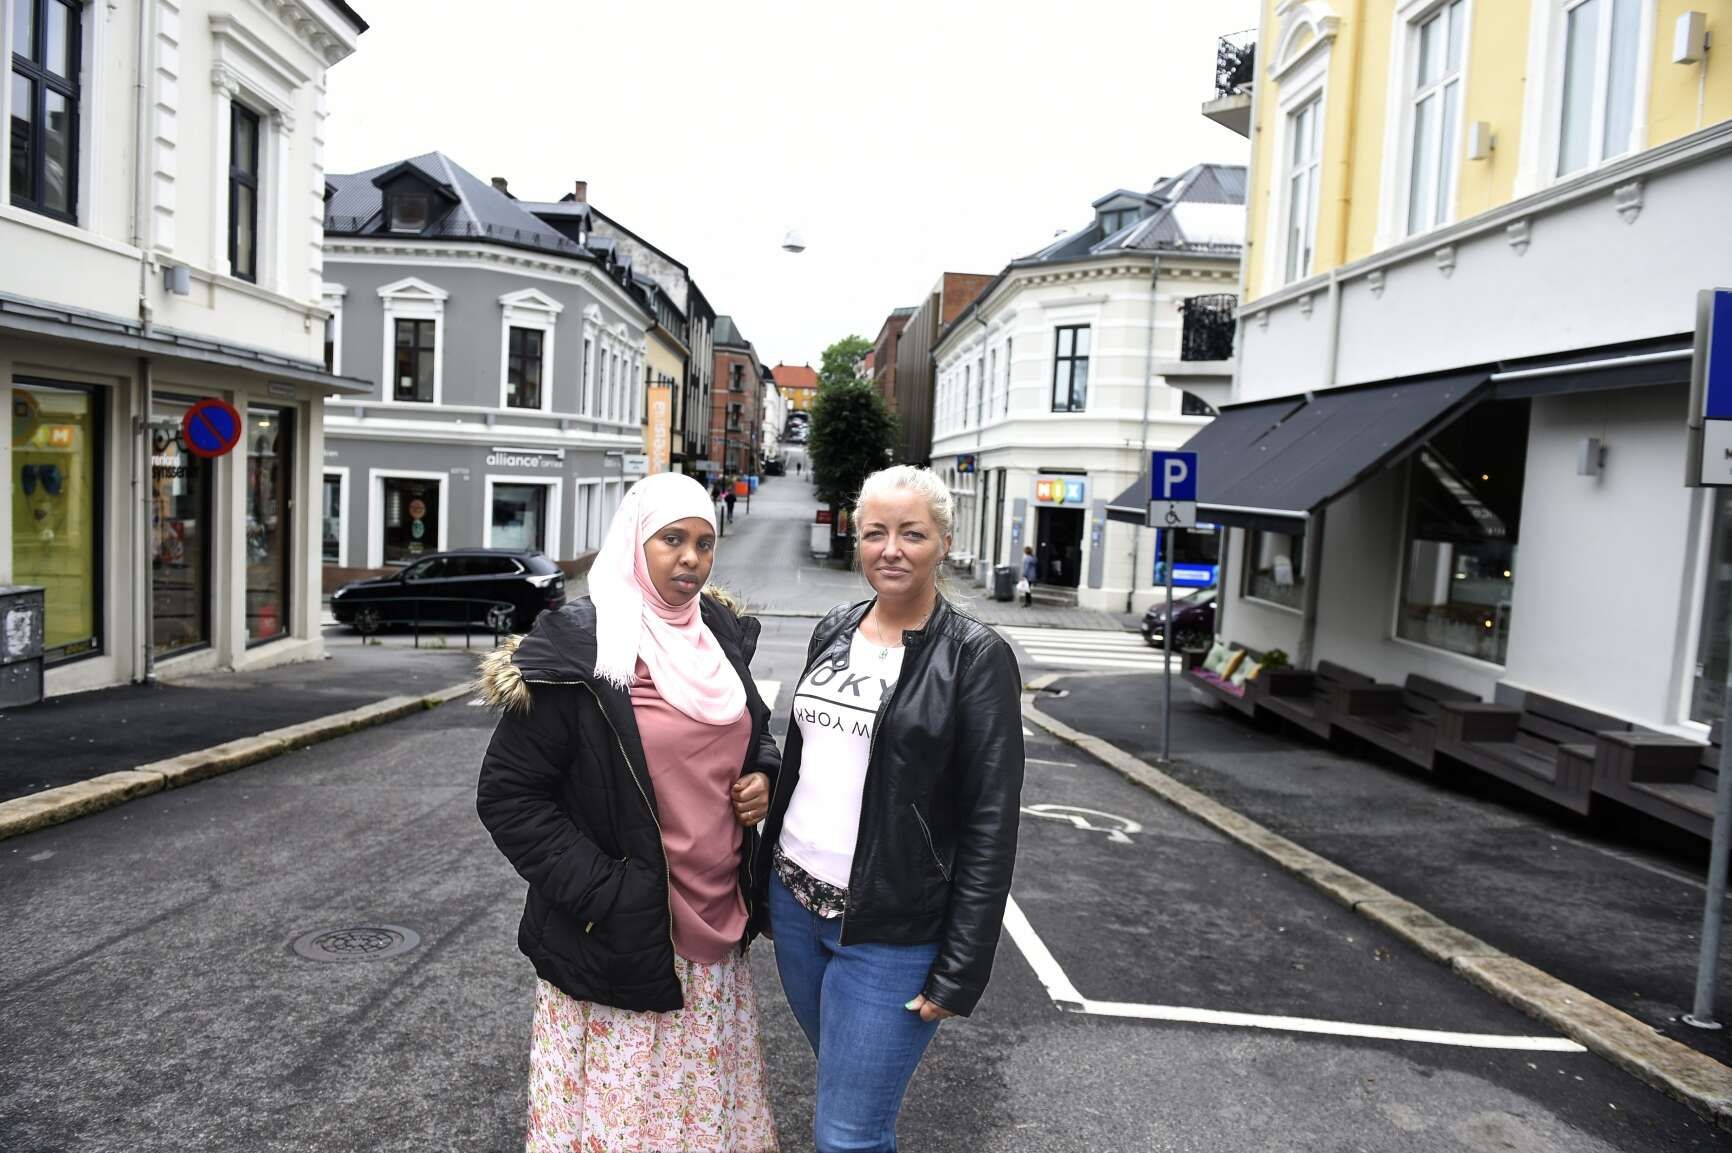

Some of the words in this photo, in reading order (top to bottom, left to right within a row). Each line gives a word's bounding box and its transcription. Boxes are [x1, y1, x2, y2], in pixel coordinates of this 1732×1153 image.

[151, 454, 181, 466] renland
[486, 453, 540, 468] alliance
[1163, 459, 1187, 497] P
[1037, 481, 1080, 499] MIX
[810, 666, 898, 702] OKY
[796, 708, 845, 732] YORK
